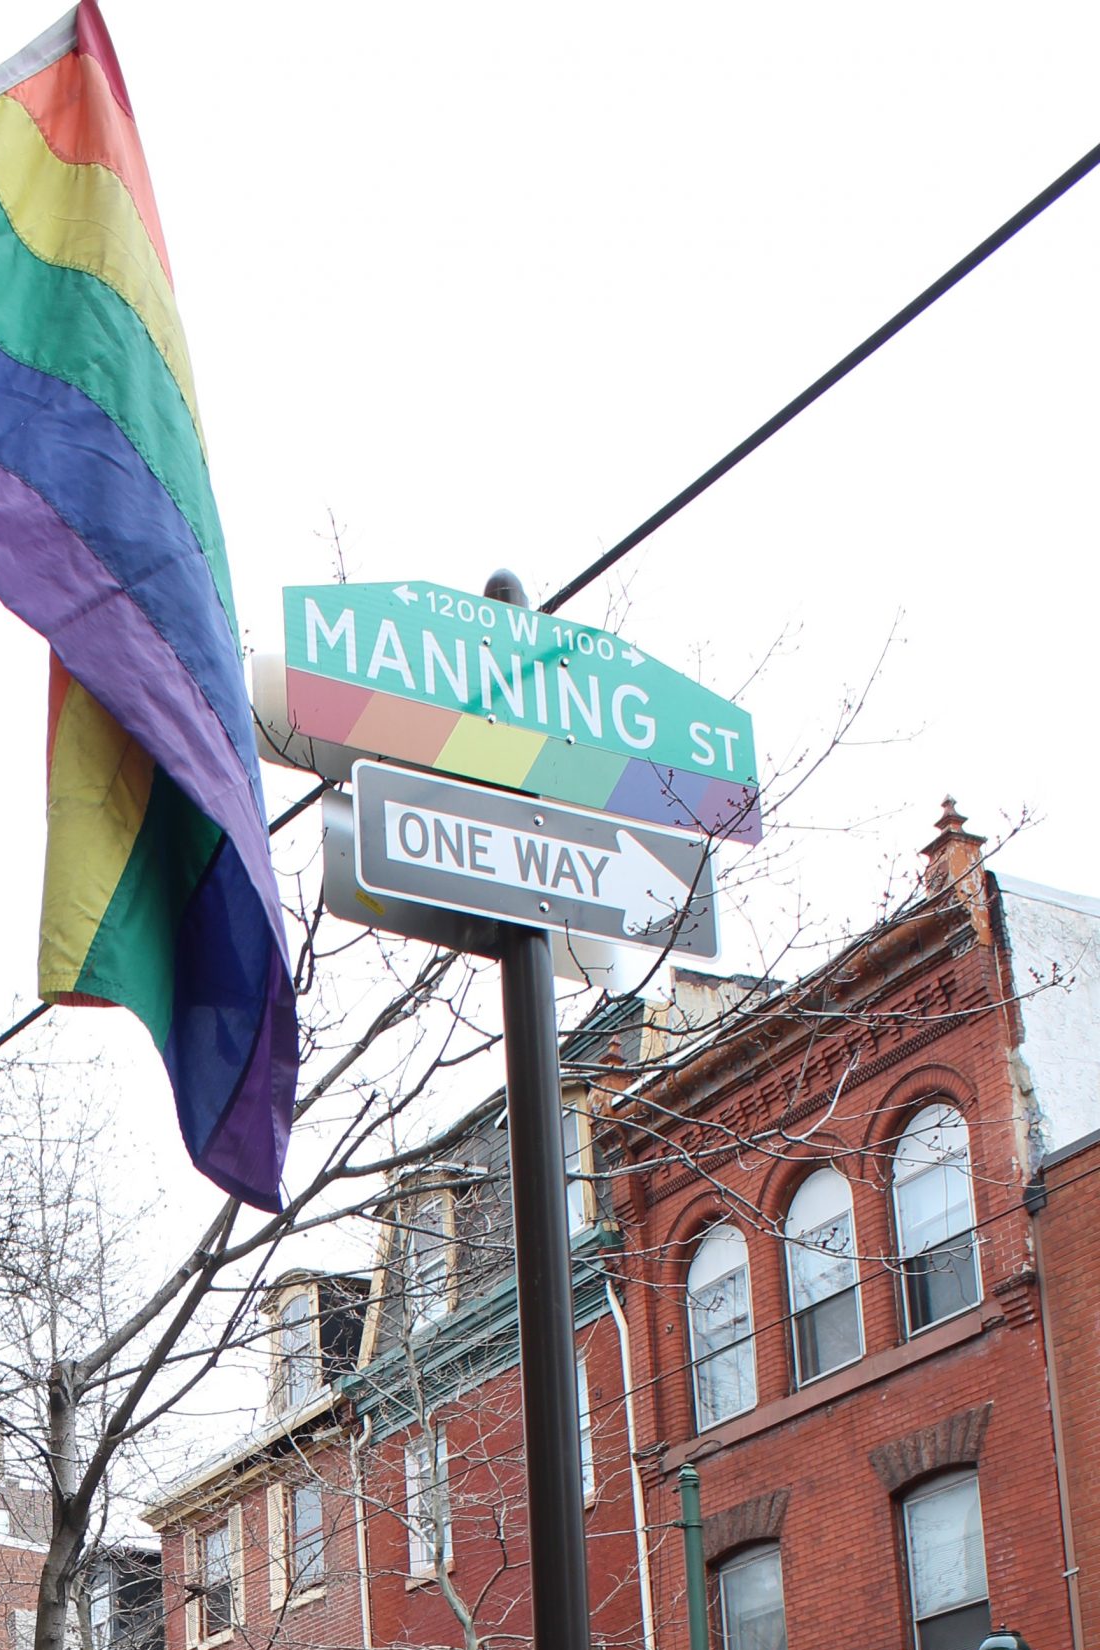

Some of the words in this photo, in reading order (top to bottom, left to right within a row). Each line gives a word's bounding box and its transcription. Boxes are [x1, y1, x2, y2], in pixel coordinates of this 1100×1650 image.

[425, 591, 497, 629] 1200
[507, 608, 538, 646] W
[551, 625, 614, 661] 1100
[304, 597, 656, 750] MANNING
[688, 721, 739, 772] ST
[399, 811, 496, 875] ONE
[514, 836, 609, 898] WAY
